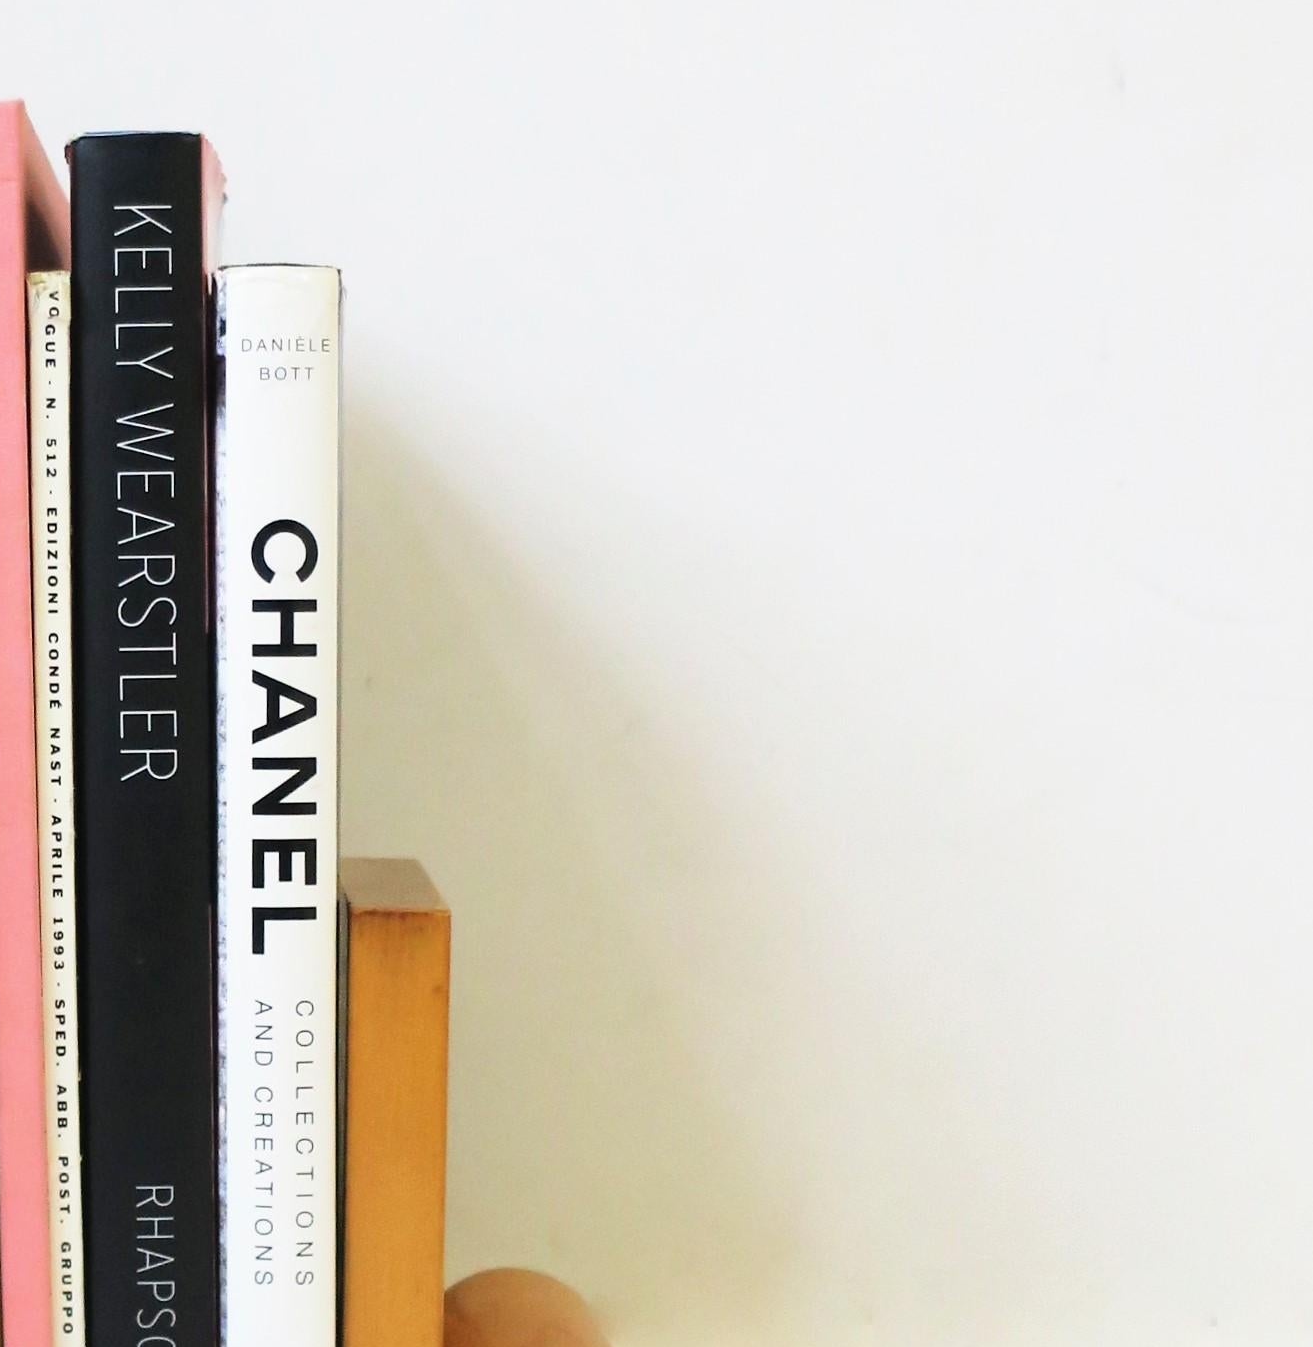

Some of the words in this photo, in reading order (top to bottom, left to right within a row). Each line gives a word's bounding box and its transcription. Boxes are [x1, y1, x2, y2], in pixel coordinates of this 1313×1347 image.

[44, 290, 61, 369] VOGUE
[113, 204, 174, 379] KELLY
[45, 397, 57, 419] N.
[259, 366, 313, 381] BOTT
[46, 438, 58, 478] 512
[46, 507, 59, 614] EDIZIONI
[115, 402, 178, 782] WEARSTLER
[48, 632, 62, 709] CONDÉ
[49, 727, 62, 786] NAST
[251, 519, 318, 954] CHANEL
[51, 814, 64, 898] APRILE
[52, 917, 65, 970] 1993
[54, 999, 67, 1066] SPED.
[254, 999, 274, 1067] AND
[56, 1084, 68, 1138] ABB.
[295, 1000, 315, 1286] COLLECTIONS
[57, 1156, 71, 1224] POST.
[254, 1086, 274, 1285] CREATIONS
[60, 1241, 74, 1334] GRUPPO
